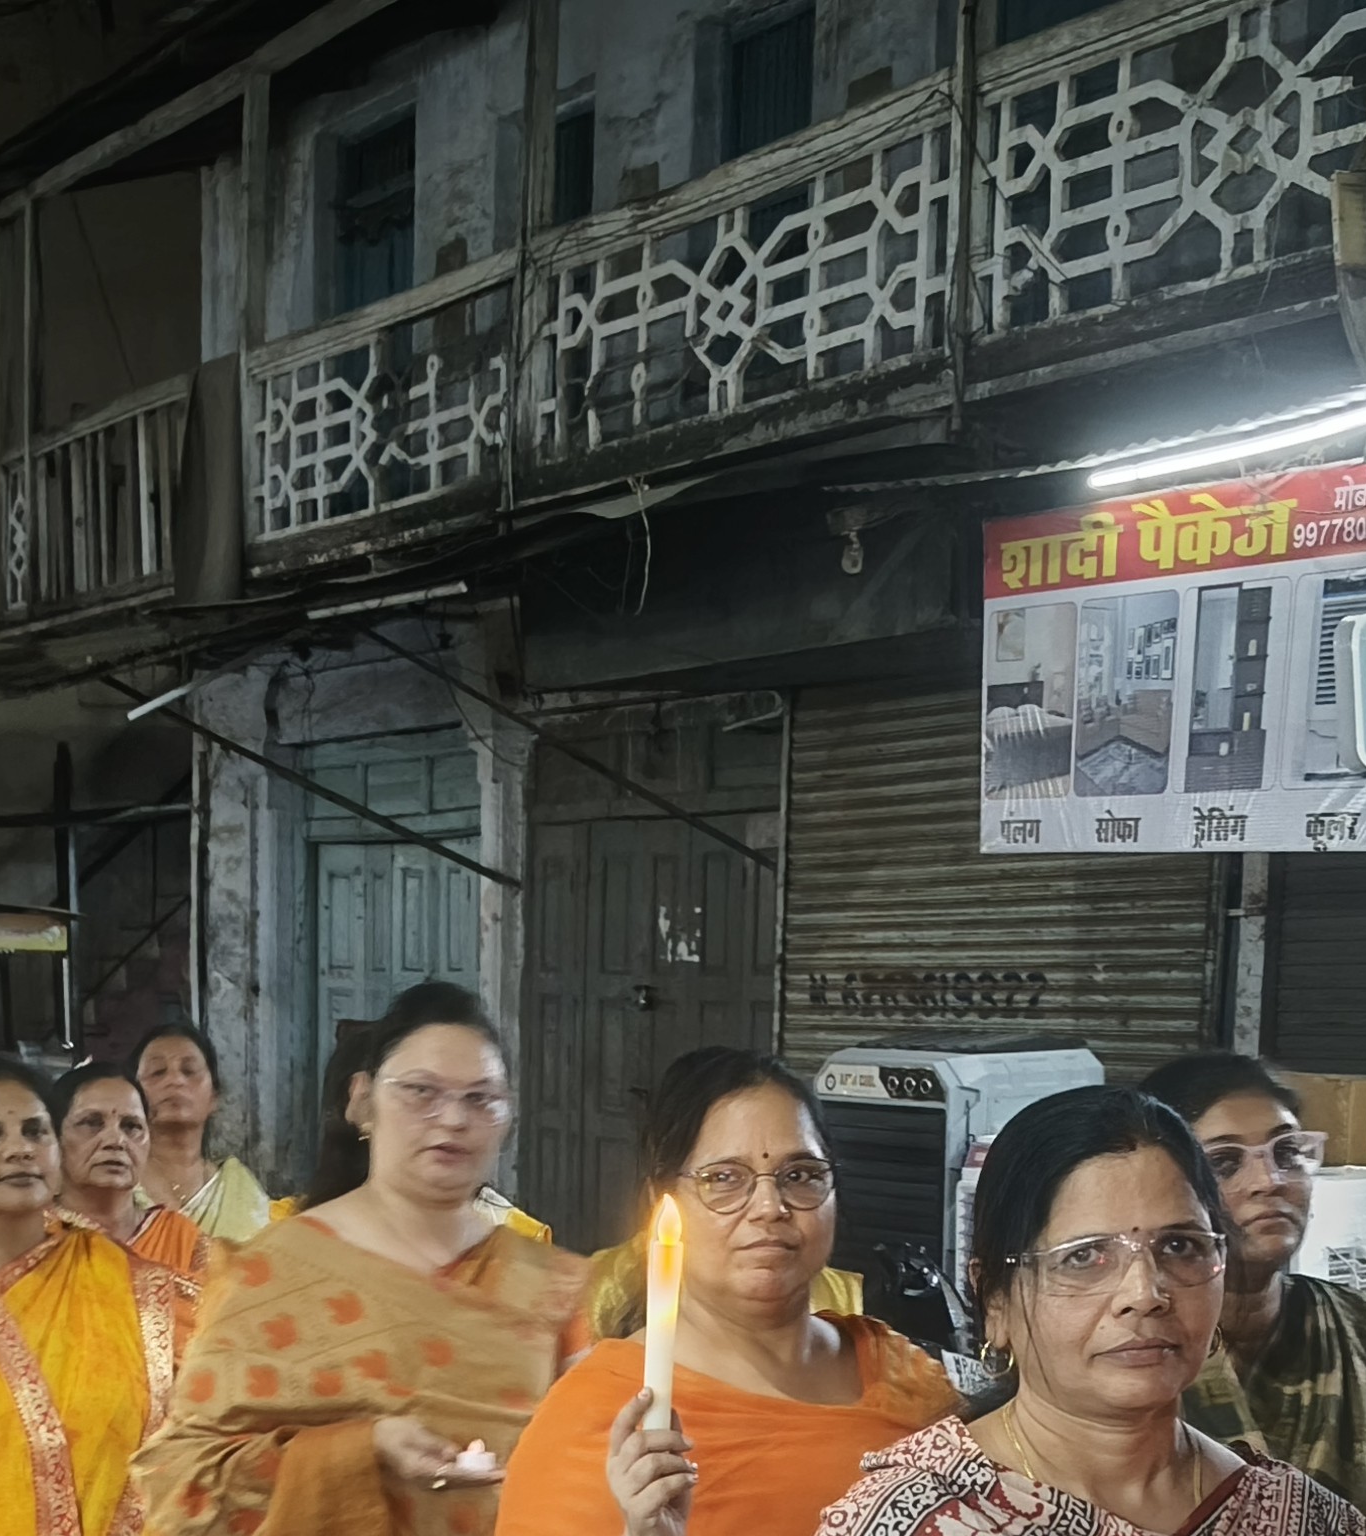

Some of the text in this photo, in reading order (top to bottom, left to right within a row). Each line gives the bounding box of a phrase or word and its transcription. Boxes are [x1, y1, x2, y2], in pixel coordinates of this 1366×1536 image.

[1000, 493, 1298, 590] शादी पैकेज
[1095, 809, 1142, 843] सोफा
